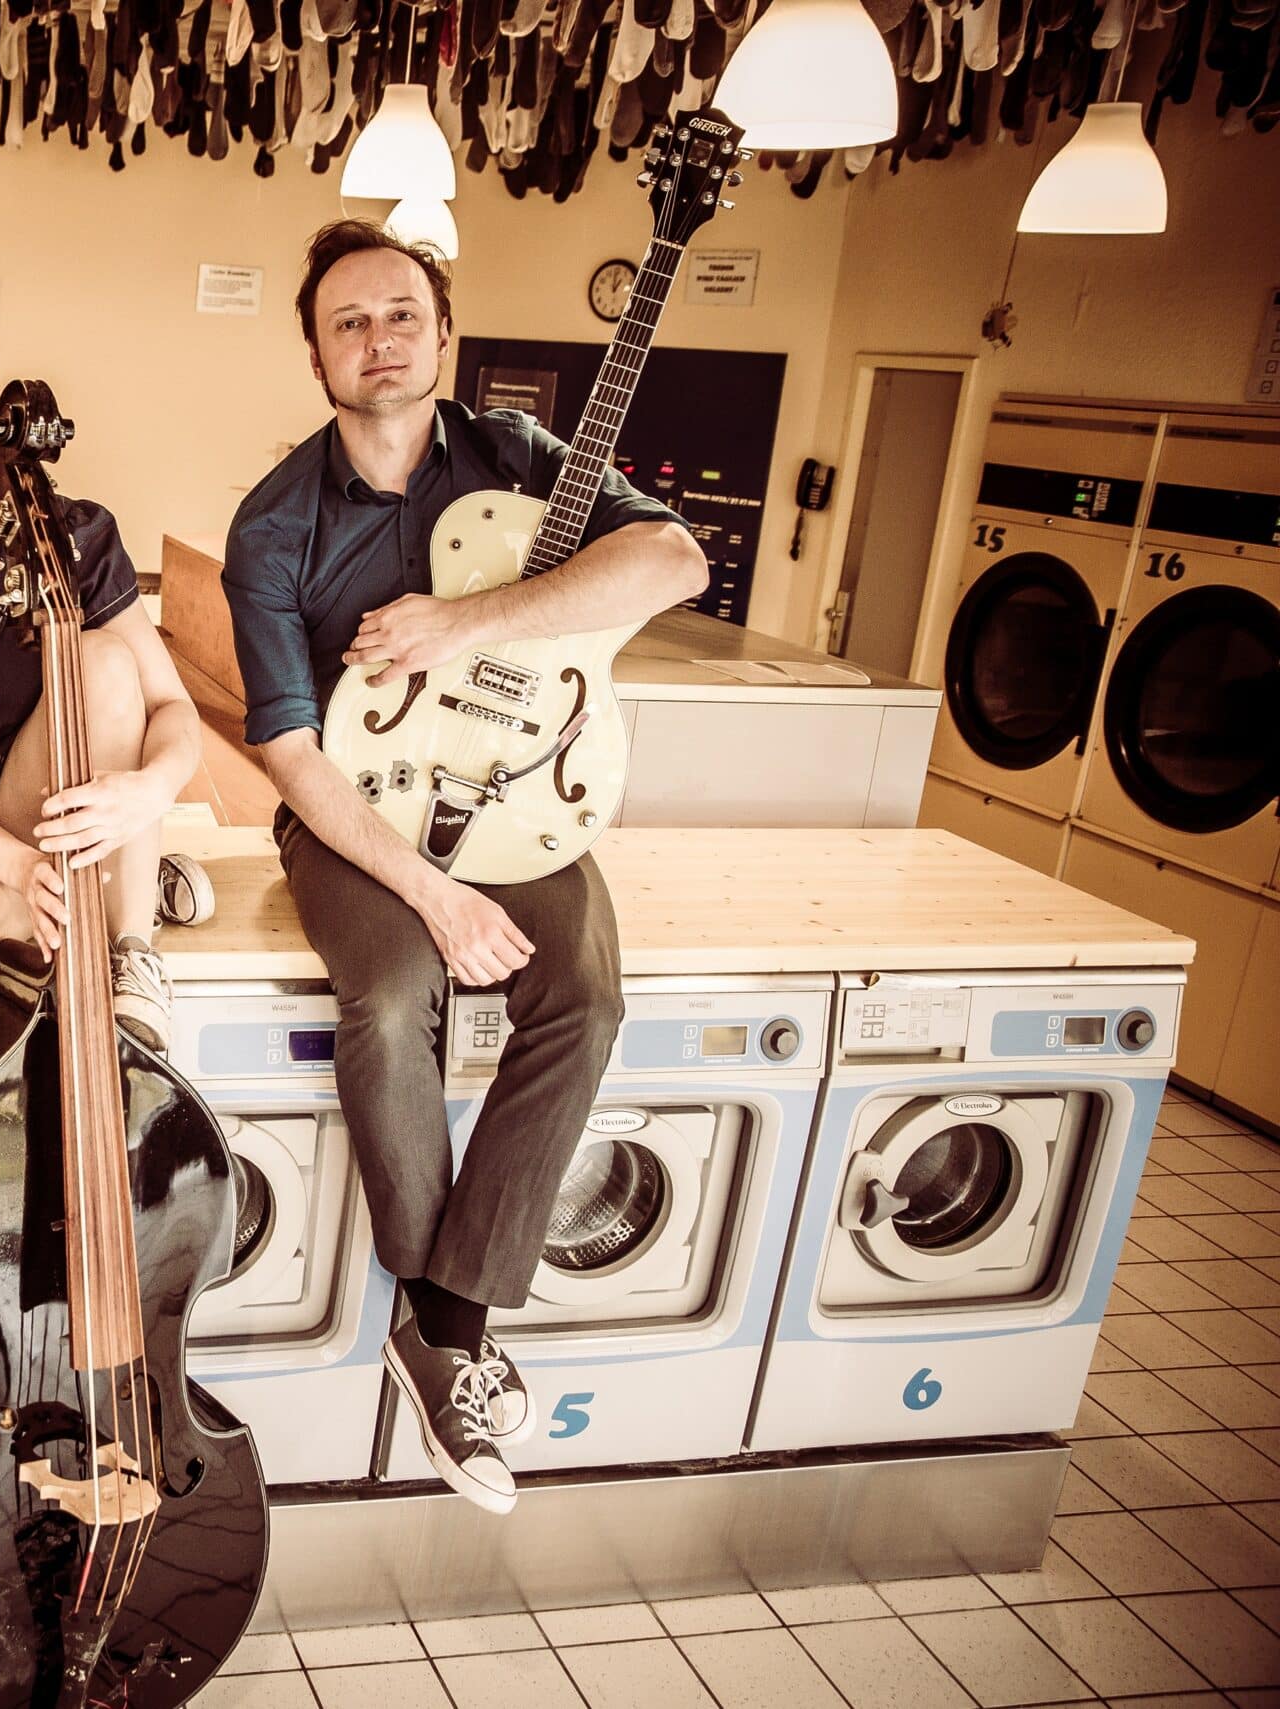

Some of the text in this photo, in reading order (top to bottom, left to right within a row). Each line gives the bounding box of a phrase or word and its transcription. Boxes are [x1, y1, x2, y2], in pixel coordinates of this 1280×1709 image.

[689, 117, 733, 137] GRETSCH
[974, 524, 1007, 553] 15
[1144, 552, 1185, 581] 16
[960, 1102, 993, 1110] Electrolux
[601, 1118, 636, 1127] Electrolux
[903, 1368, 942, 1410] 6
[549, 1392, 595, 1439] 5
